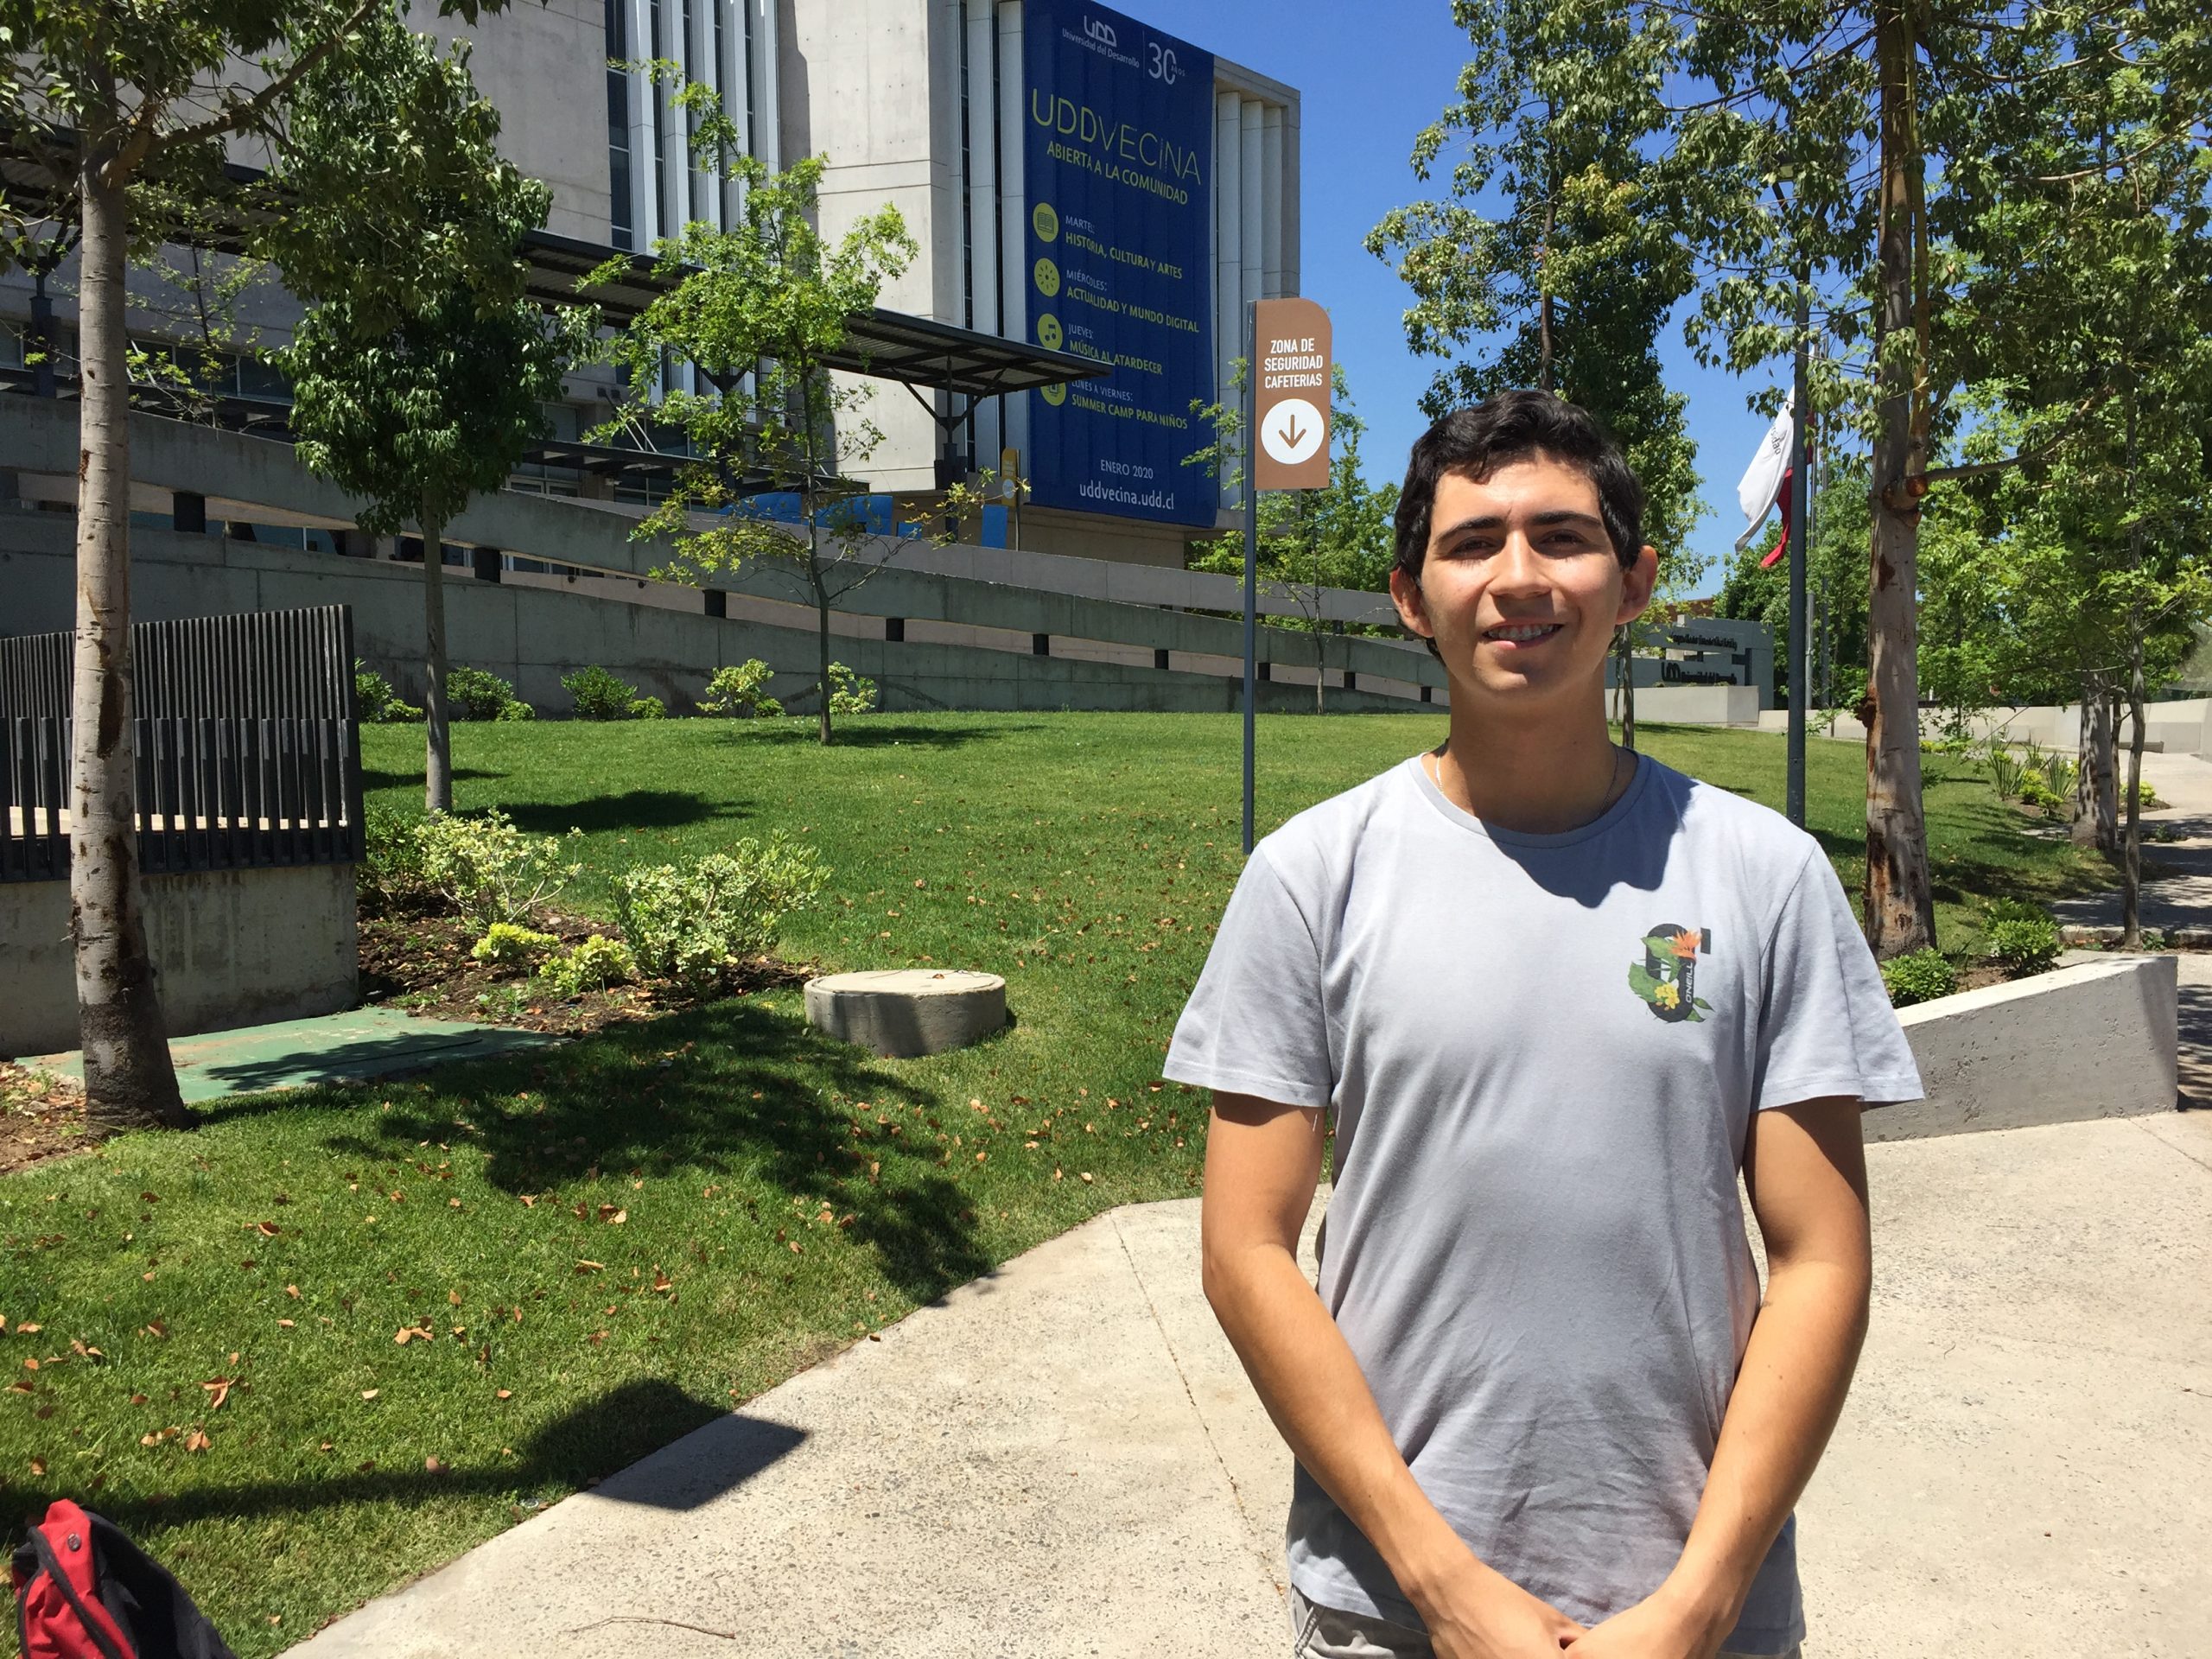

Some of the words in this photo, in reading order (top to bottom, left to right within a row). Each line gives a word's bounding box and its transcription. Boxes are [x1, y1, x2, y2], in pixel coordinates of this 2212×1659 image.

[1062, 28, 1096, 51] Universidad
[1096, 44, 1107, 55] del
[1107, 48, 1140, 68] Desarrollo
[1148, 41, 1176, 85] 30
[1046, 141, 1092, 171] ABIERTA
[1094, 159, 1102, 175] A
[1105, 163, 1120, 181] LA
[1122, 169, 1188, 206] COMUNIDAD
[1065, 232, 1107, 258] HISTORIA,
[1109, 247, 1149, 270] CULTURA
[1149, 259, 1156, 271] Y
[1157, 263, 1182, 279] ARTES
[1066, 269, 1107, 291] MIÉRCOLES:
[1067, 286, 1119, 312] ACTUALIDAD
[1122, 303, 1128, 315] Y
[1129, 305, 1163, 324] MUNDO
[1166, 315, 1199, 333] DIGITAL
[1069, 339, 1099, 360] MÚSICA
[1101, 350, 1112, 363] AL
[1114, 353, 1163, 375] ATARDECER
[1270, 338, 1298, 354] ZONA
[1300, 338, 1315, 353] DE
[1264, 354, 1323, 372] SEGURIDAD
[1071, 380, 1092, 392] LUNES
[1094, 385, 1099, 394] A
[1100, 386, 1134, 402] VIERNES:
[1264, 373, 1323, 389] CAFETERIAS
[1071, 394, 1106, 414] SUMMER
[1108, 404, 1134, 419] CAMP
[1136, 409, 1158, 424] PARA
[1159, 413, 1188, 429] NIÑOS
[1100, 459, 1130, 475] ENERO
[1132, 465, 1154, 480] 2020
[1079, 480, 1174, 511] uddvecina.udd.cl
